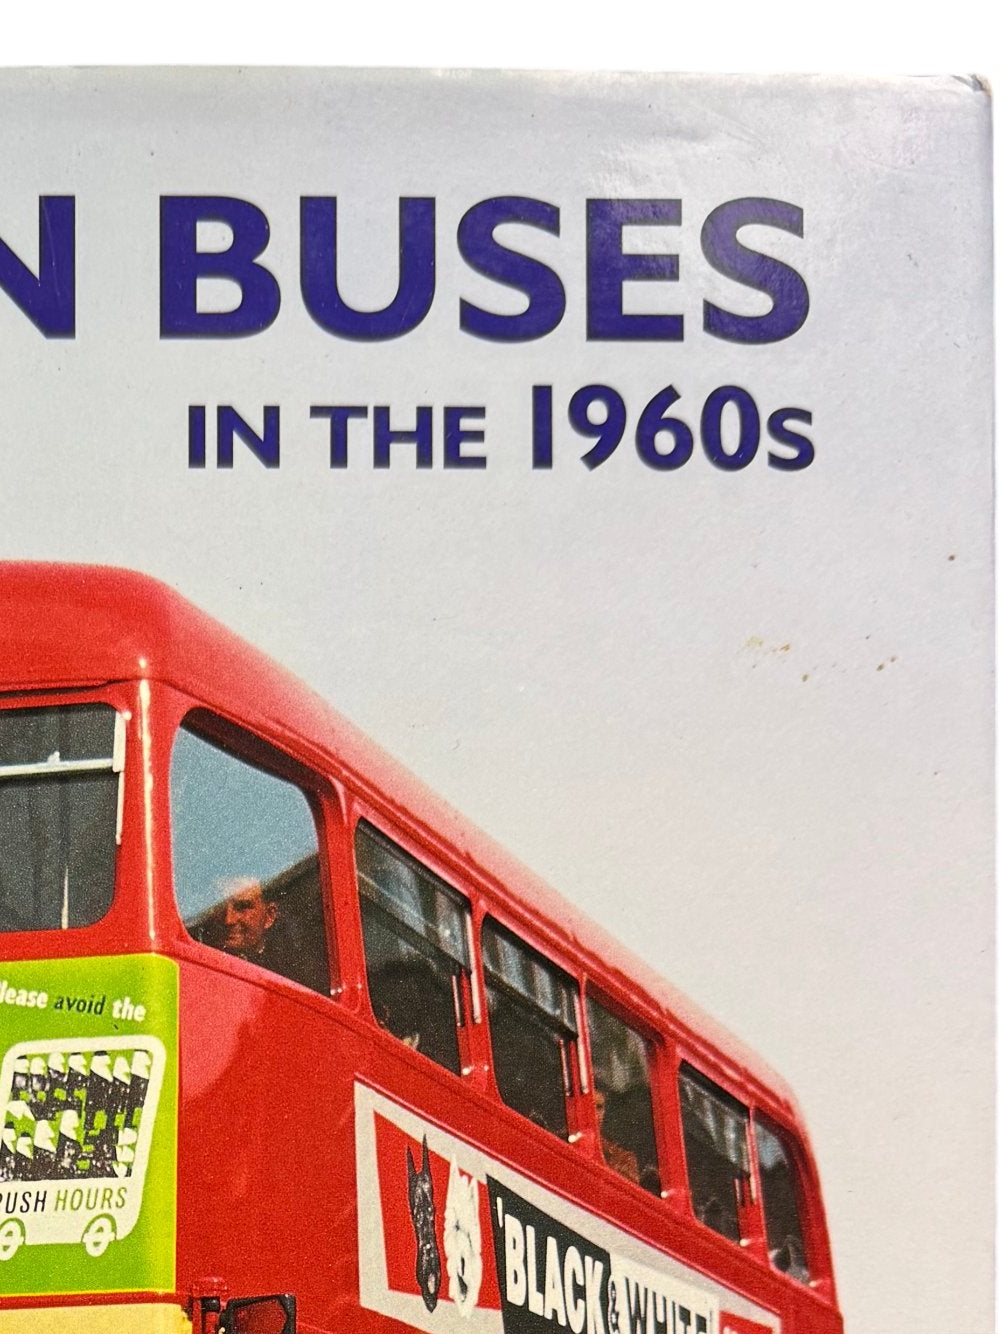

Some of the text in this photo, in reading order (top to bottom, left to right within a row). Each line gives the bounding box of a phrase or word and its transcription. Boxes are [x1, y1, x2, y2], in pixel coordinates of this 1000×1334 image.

[160, 195, 810, 344] BUSES
[187, 403, 278, 469] IN
[311, 402, 488, 468] THE
[53, 994, 106, 1015] avoid
[112, 997, 146, 1022] the
[53, 1186, 128, 1211] HOURS
